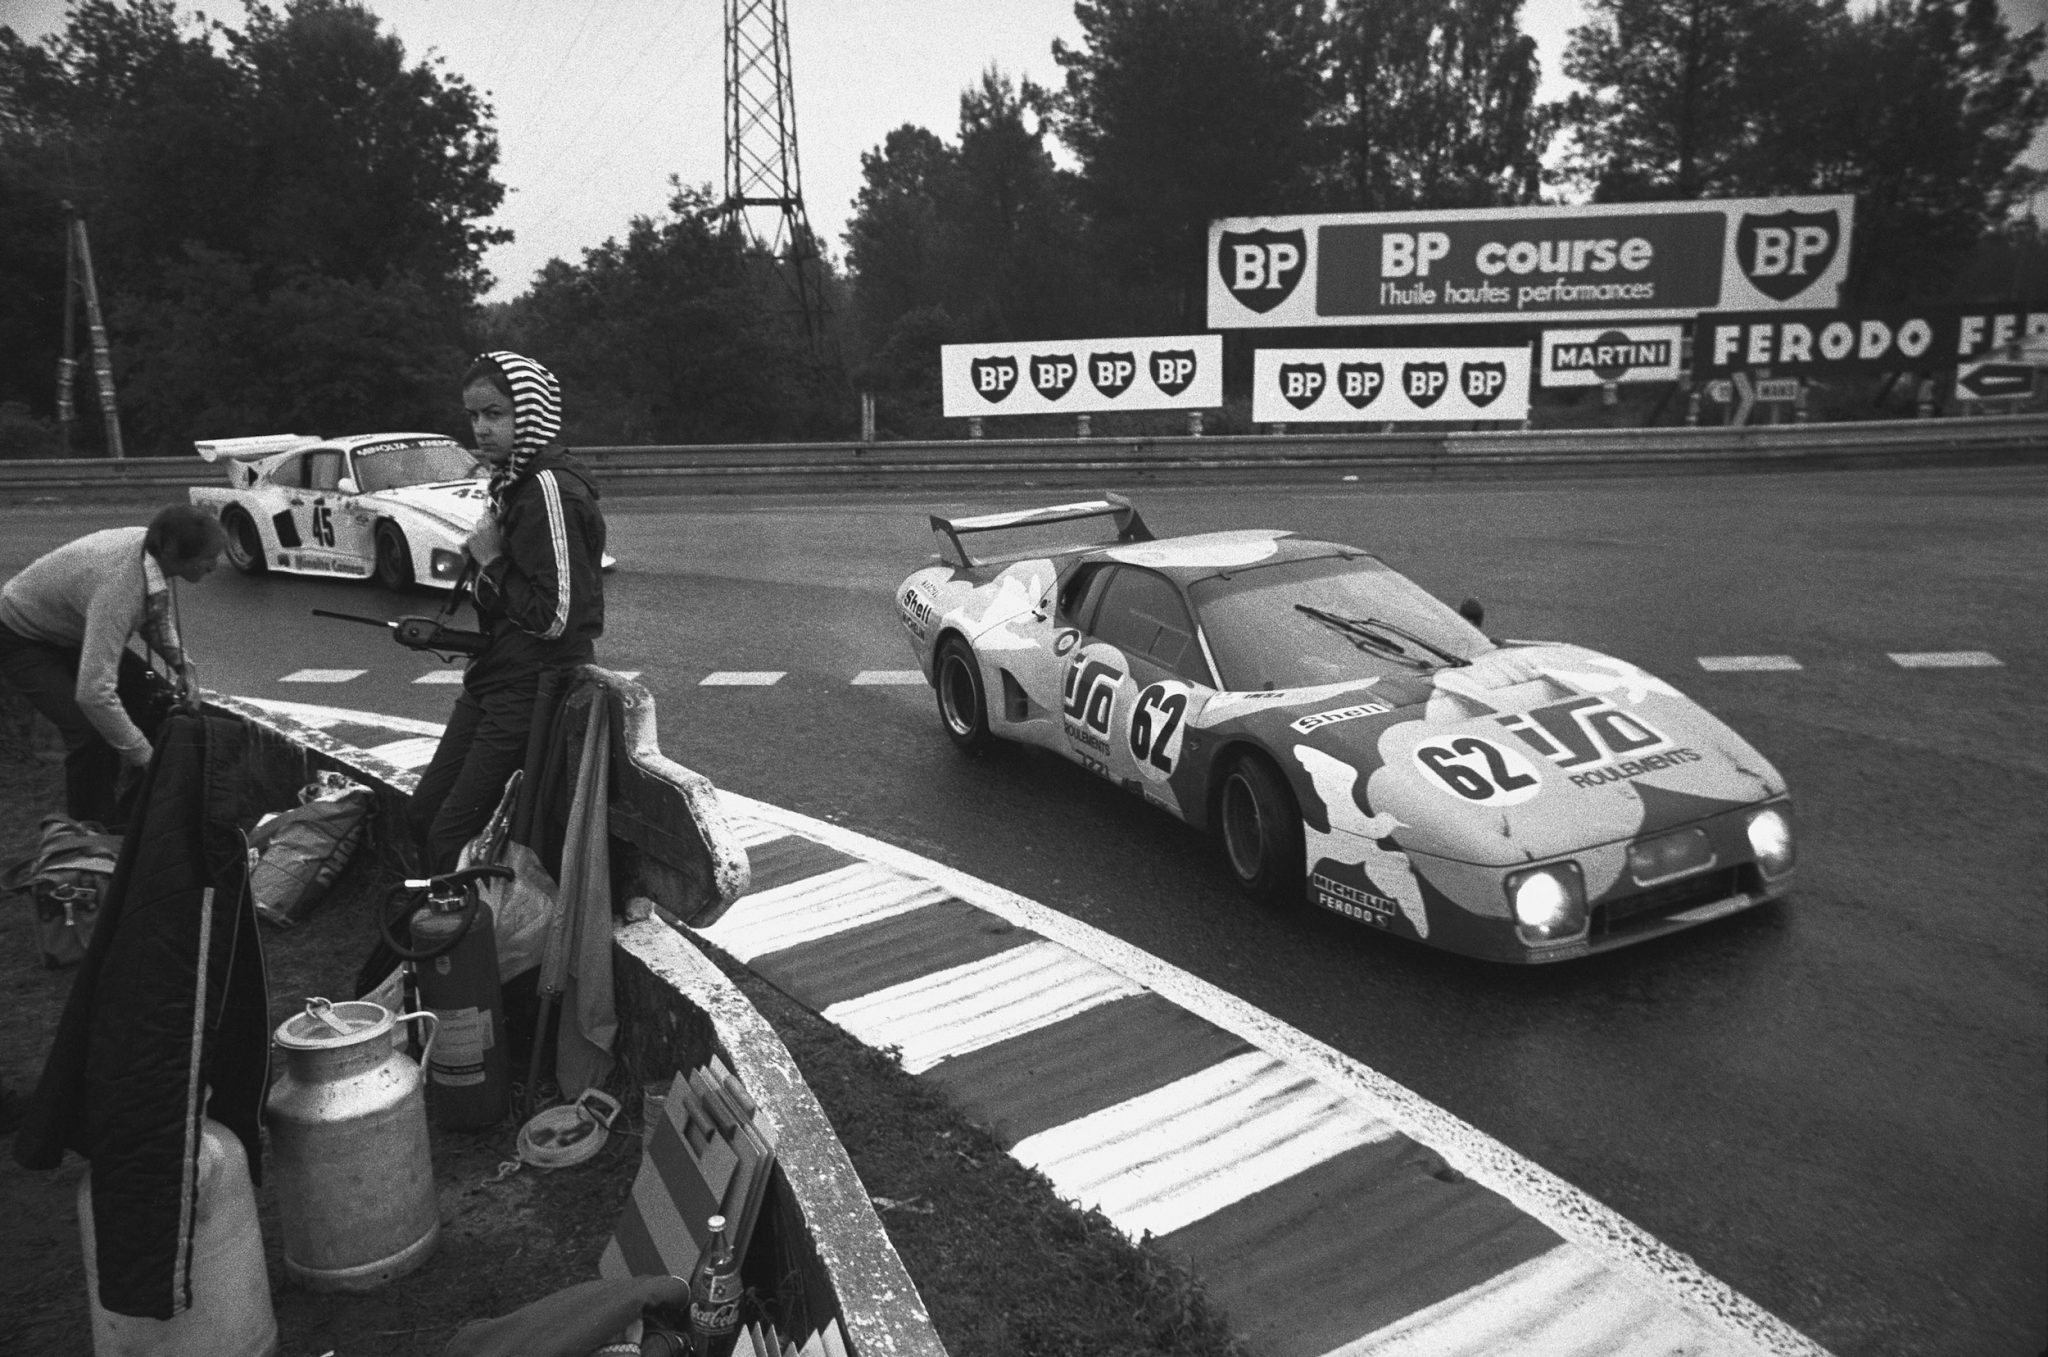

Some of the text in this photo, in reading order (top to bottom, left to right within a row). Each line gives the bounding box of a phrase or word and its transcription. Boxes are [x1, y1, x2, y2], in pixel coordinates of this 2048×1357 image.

[1231, 243, 1300, 290] BP
[1380, 231, 1654, 278] BP course
[1750, 225, 1830, 277] BP
[1444, 279, 1511, 304] hautes
[1517, 276, 1655, 310] performances
[1556, 343, 1667, 369] MARTINI
[1713, 318, 1933, 365] FERODO
[978, 357, 1194, 392] BP BP BP BP
[1285, 369, 1503, 398] BP BP BP BP
[312, 506, 336, 548] 45
[903, 588, 932, 625] Shell
[1130, 684, 1188, 775] 62
[1298, 704, 1384, 730] Shell
[1063, 721, 1112, 757] ROULEMENTS
[1416, 737, 1539, 801] 62
[1568, 748, 1703, 789] ROULEMENTS
[1313, 873, 1396, 916] MICHELIN
[1319, 892, 1373, 923] FERODO
